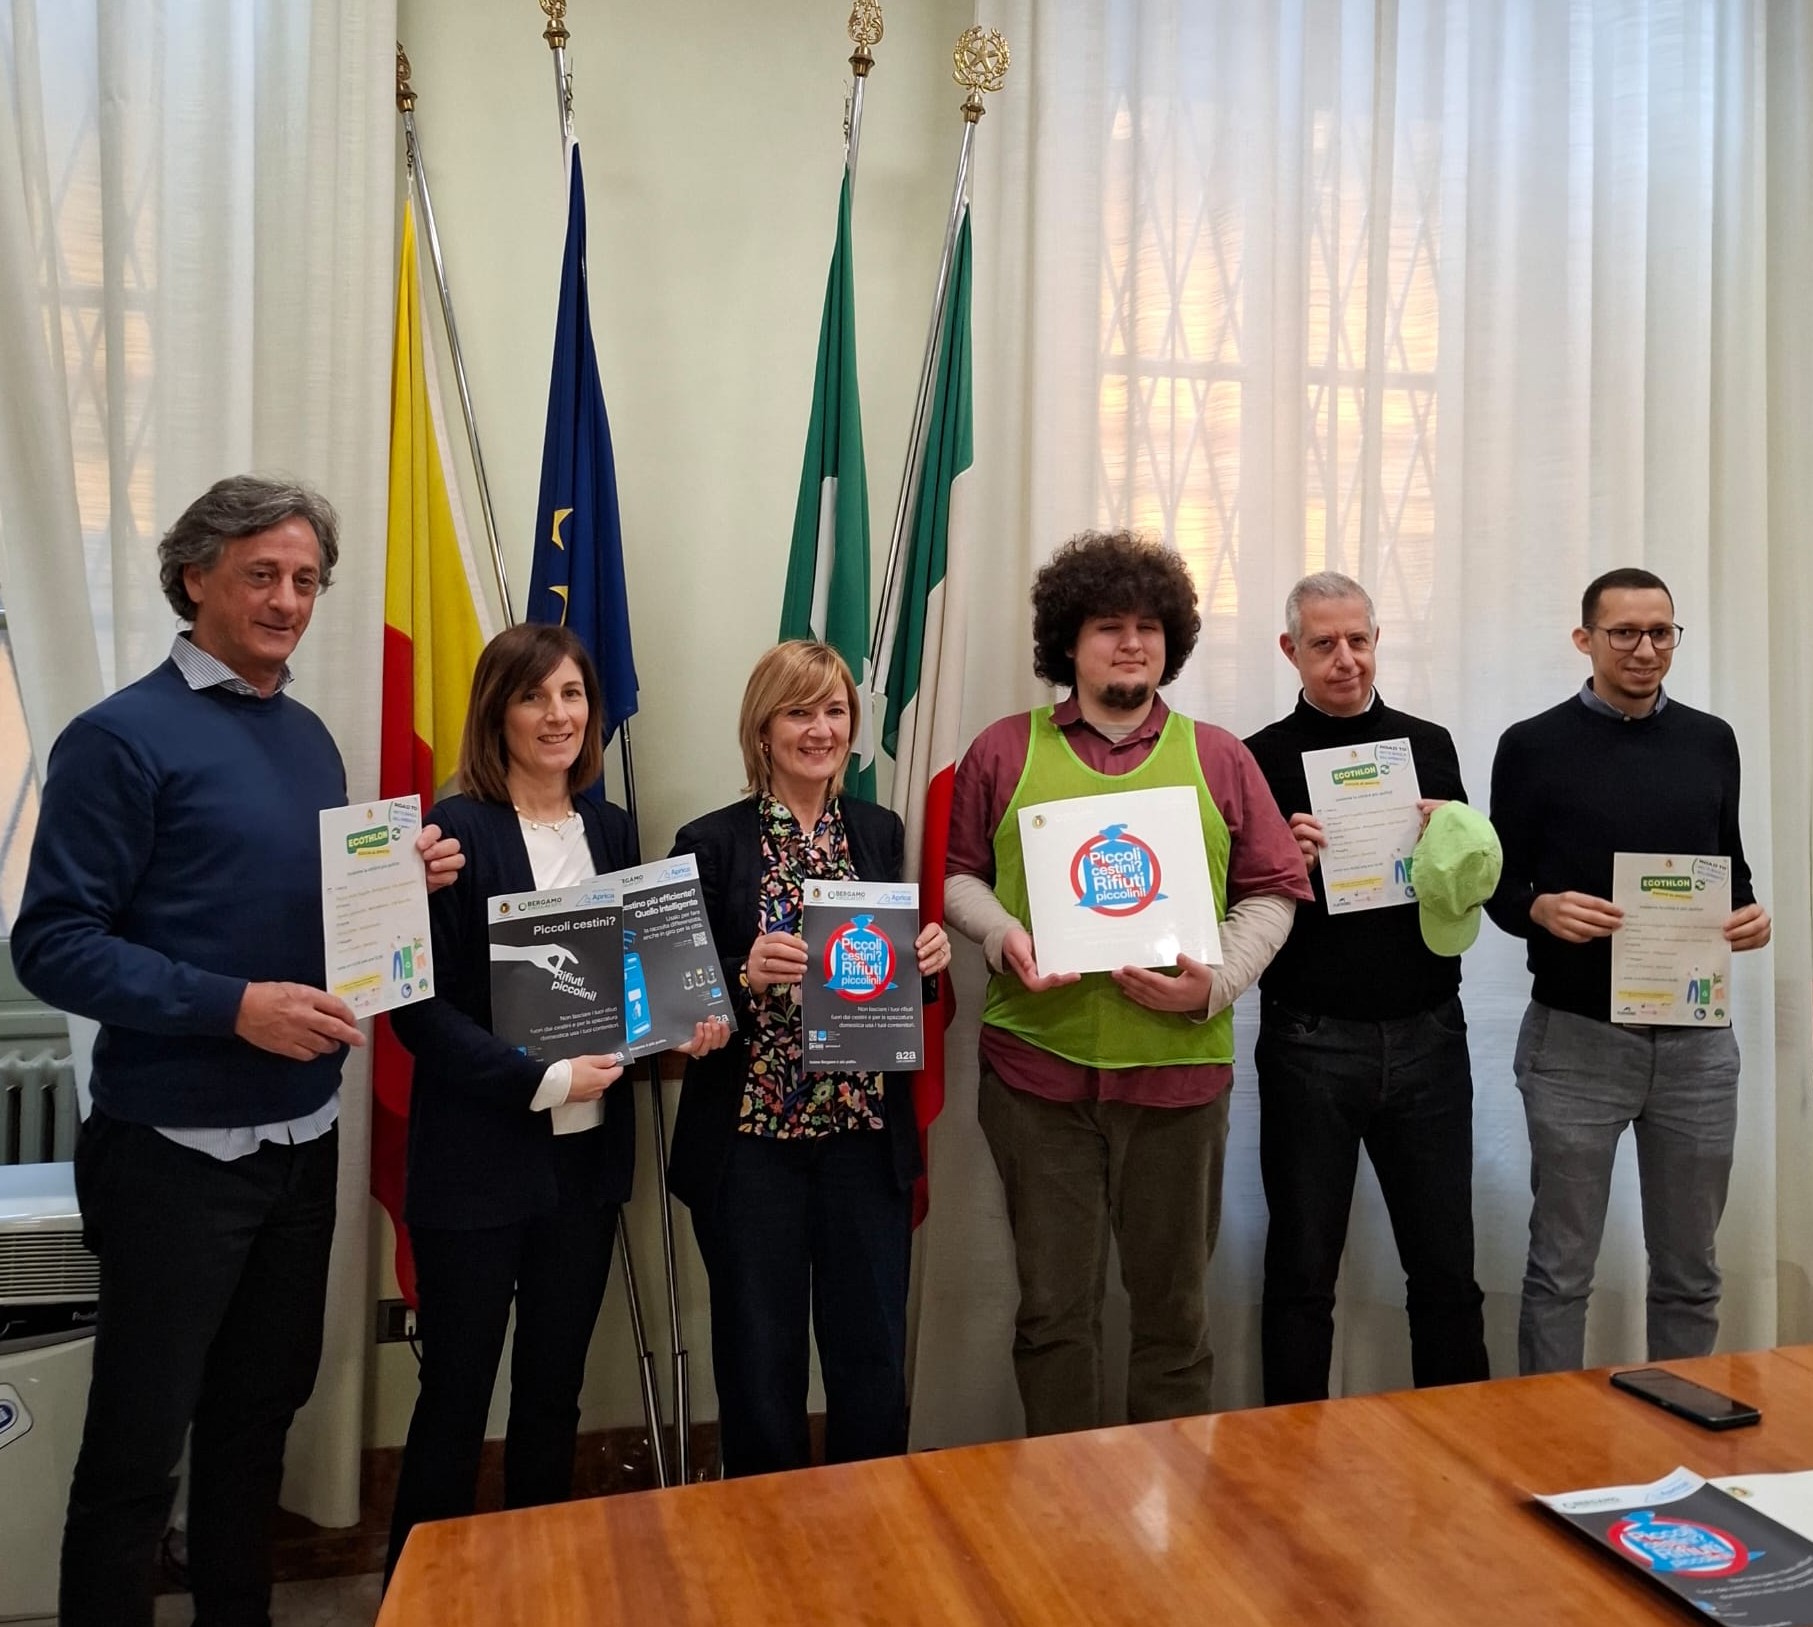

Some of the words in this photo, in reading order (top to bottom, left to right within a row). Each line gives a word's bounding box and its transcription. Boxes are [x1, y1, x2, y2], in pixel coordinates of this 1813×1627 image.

[1334, 766, 1376, 780] ECOTHLON
[348, 831, 388, 848] ECOTHLON
[1090, 847, 1141, 865] Piccoli
[1091, 861, 1142, 877] cestini?
[1093, 872, 1145, 892] Rifiuti
[1642, 879, 1690, 887] ECOTHLON
[527, 897, 562, 906] BERGAMO
[835, 890, 866, 898] BERGAMO
[1096, 888, 1147, 904] piccolini!
[623, 898, 646, 911] estino
[647, 896, 659, 908] più
[635, 906, 659, 919] Quello
[533, 919, 570, 936] Piccoli
[573, 916, 616, 931] cestini?
[841, 937, 882, 951] Piccoli
[841, 950, 882, 962] cestini?
[841, 961, 882, 976] Rifiuti
[554, 969, 585, 988] Rifiuti
[841, 976, 882, 987] piccolini!
[551, 980, 598, 1002] piccolini!
[896, 1051, 916, 1060] a2a
